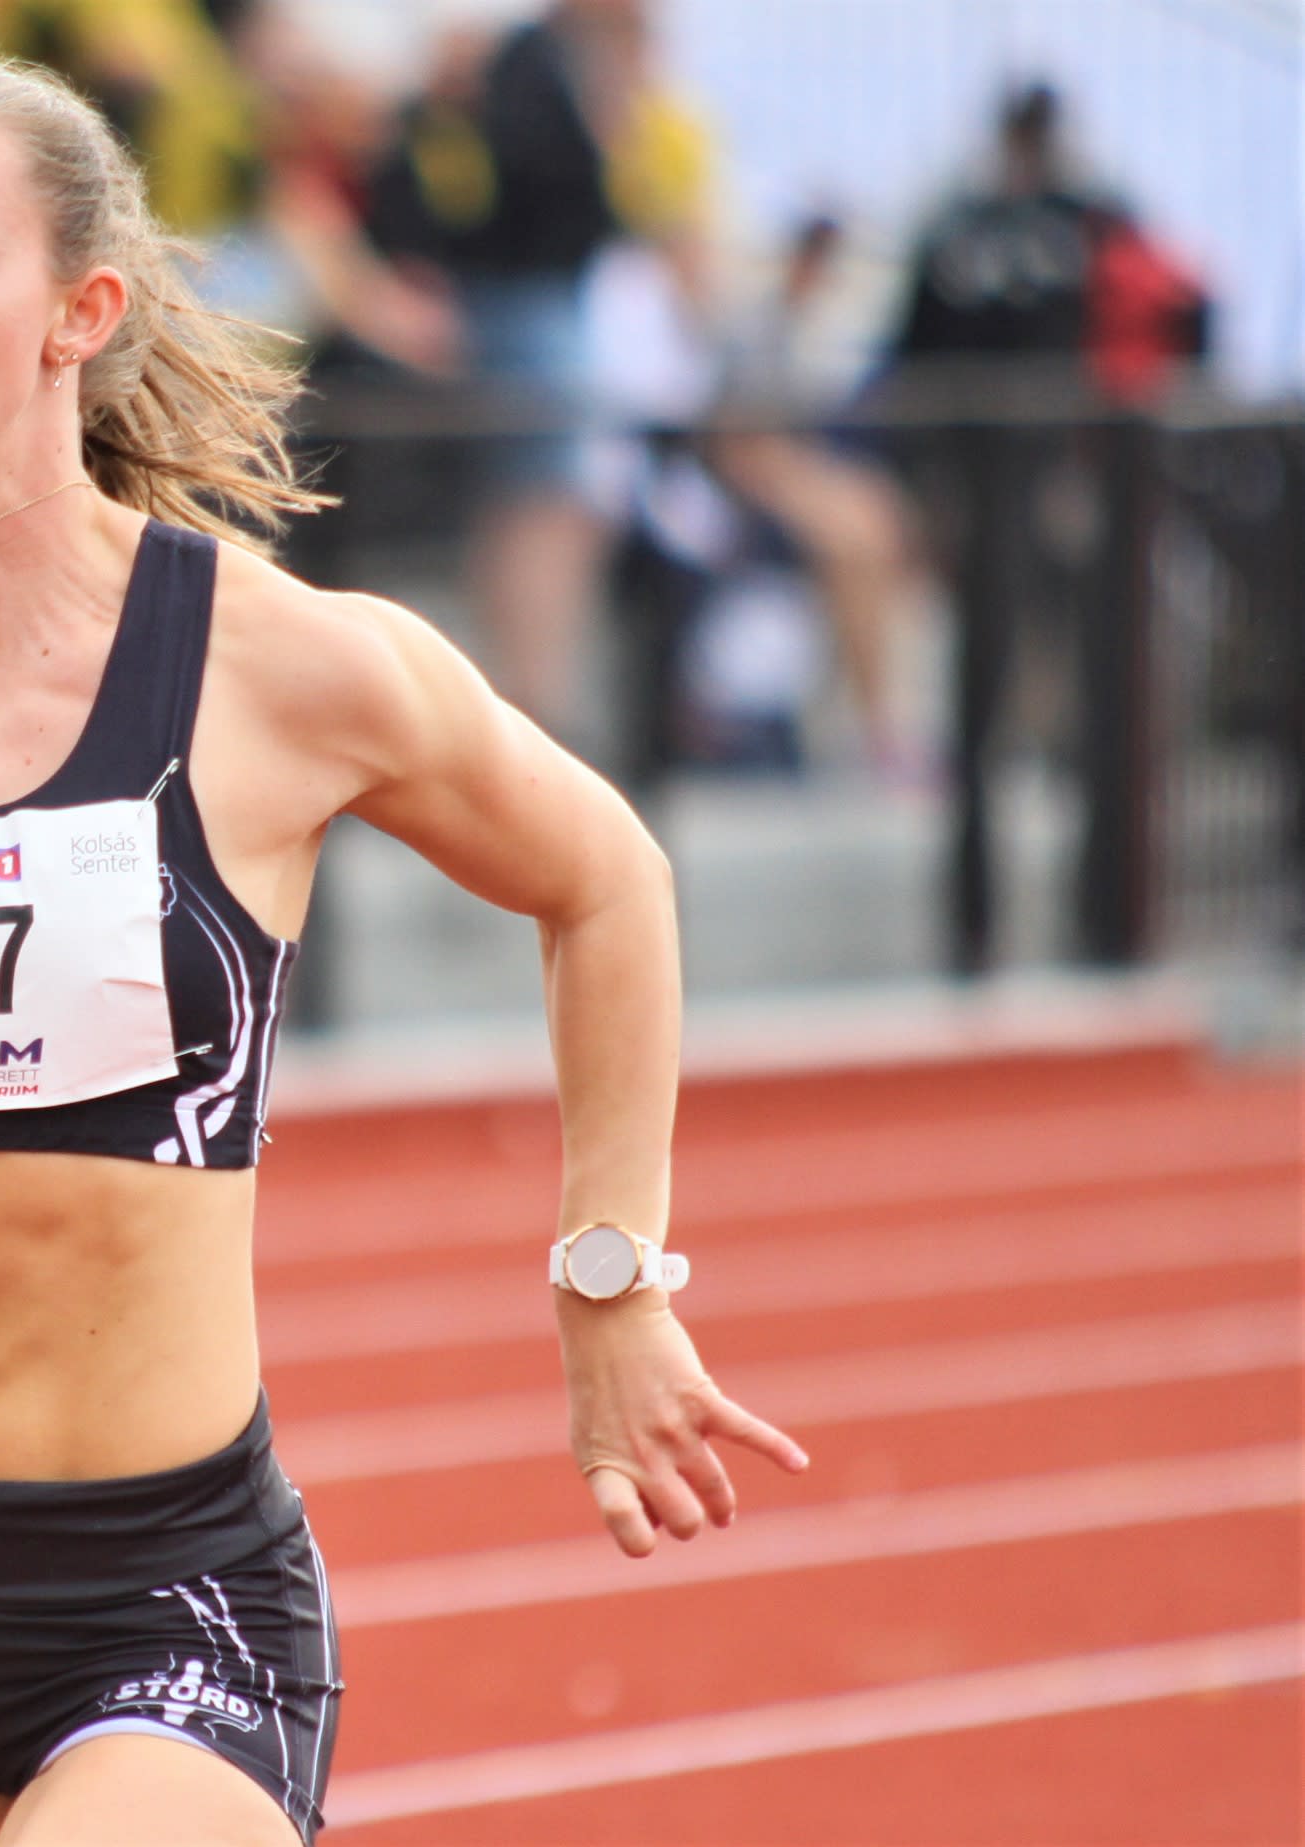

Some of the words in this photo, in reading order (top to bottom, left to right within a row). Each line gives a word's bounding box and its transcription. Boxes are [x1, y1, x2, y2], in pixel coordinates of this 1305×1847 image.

[70, 831, 137, 854] Kolsås
[1, 854, 15, 875] 1
[70, 855, 141, 876] Senter
[114, 1679, 251, 1719] STORD
